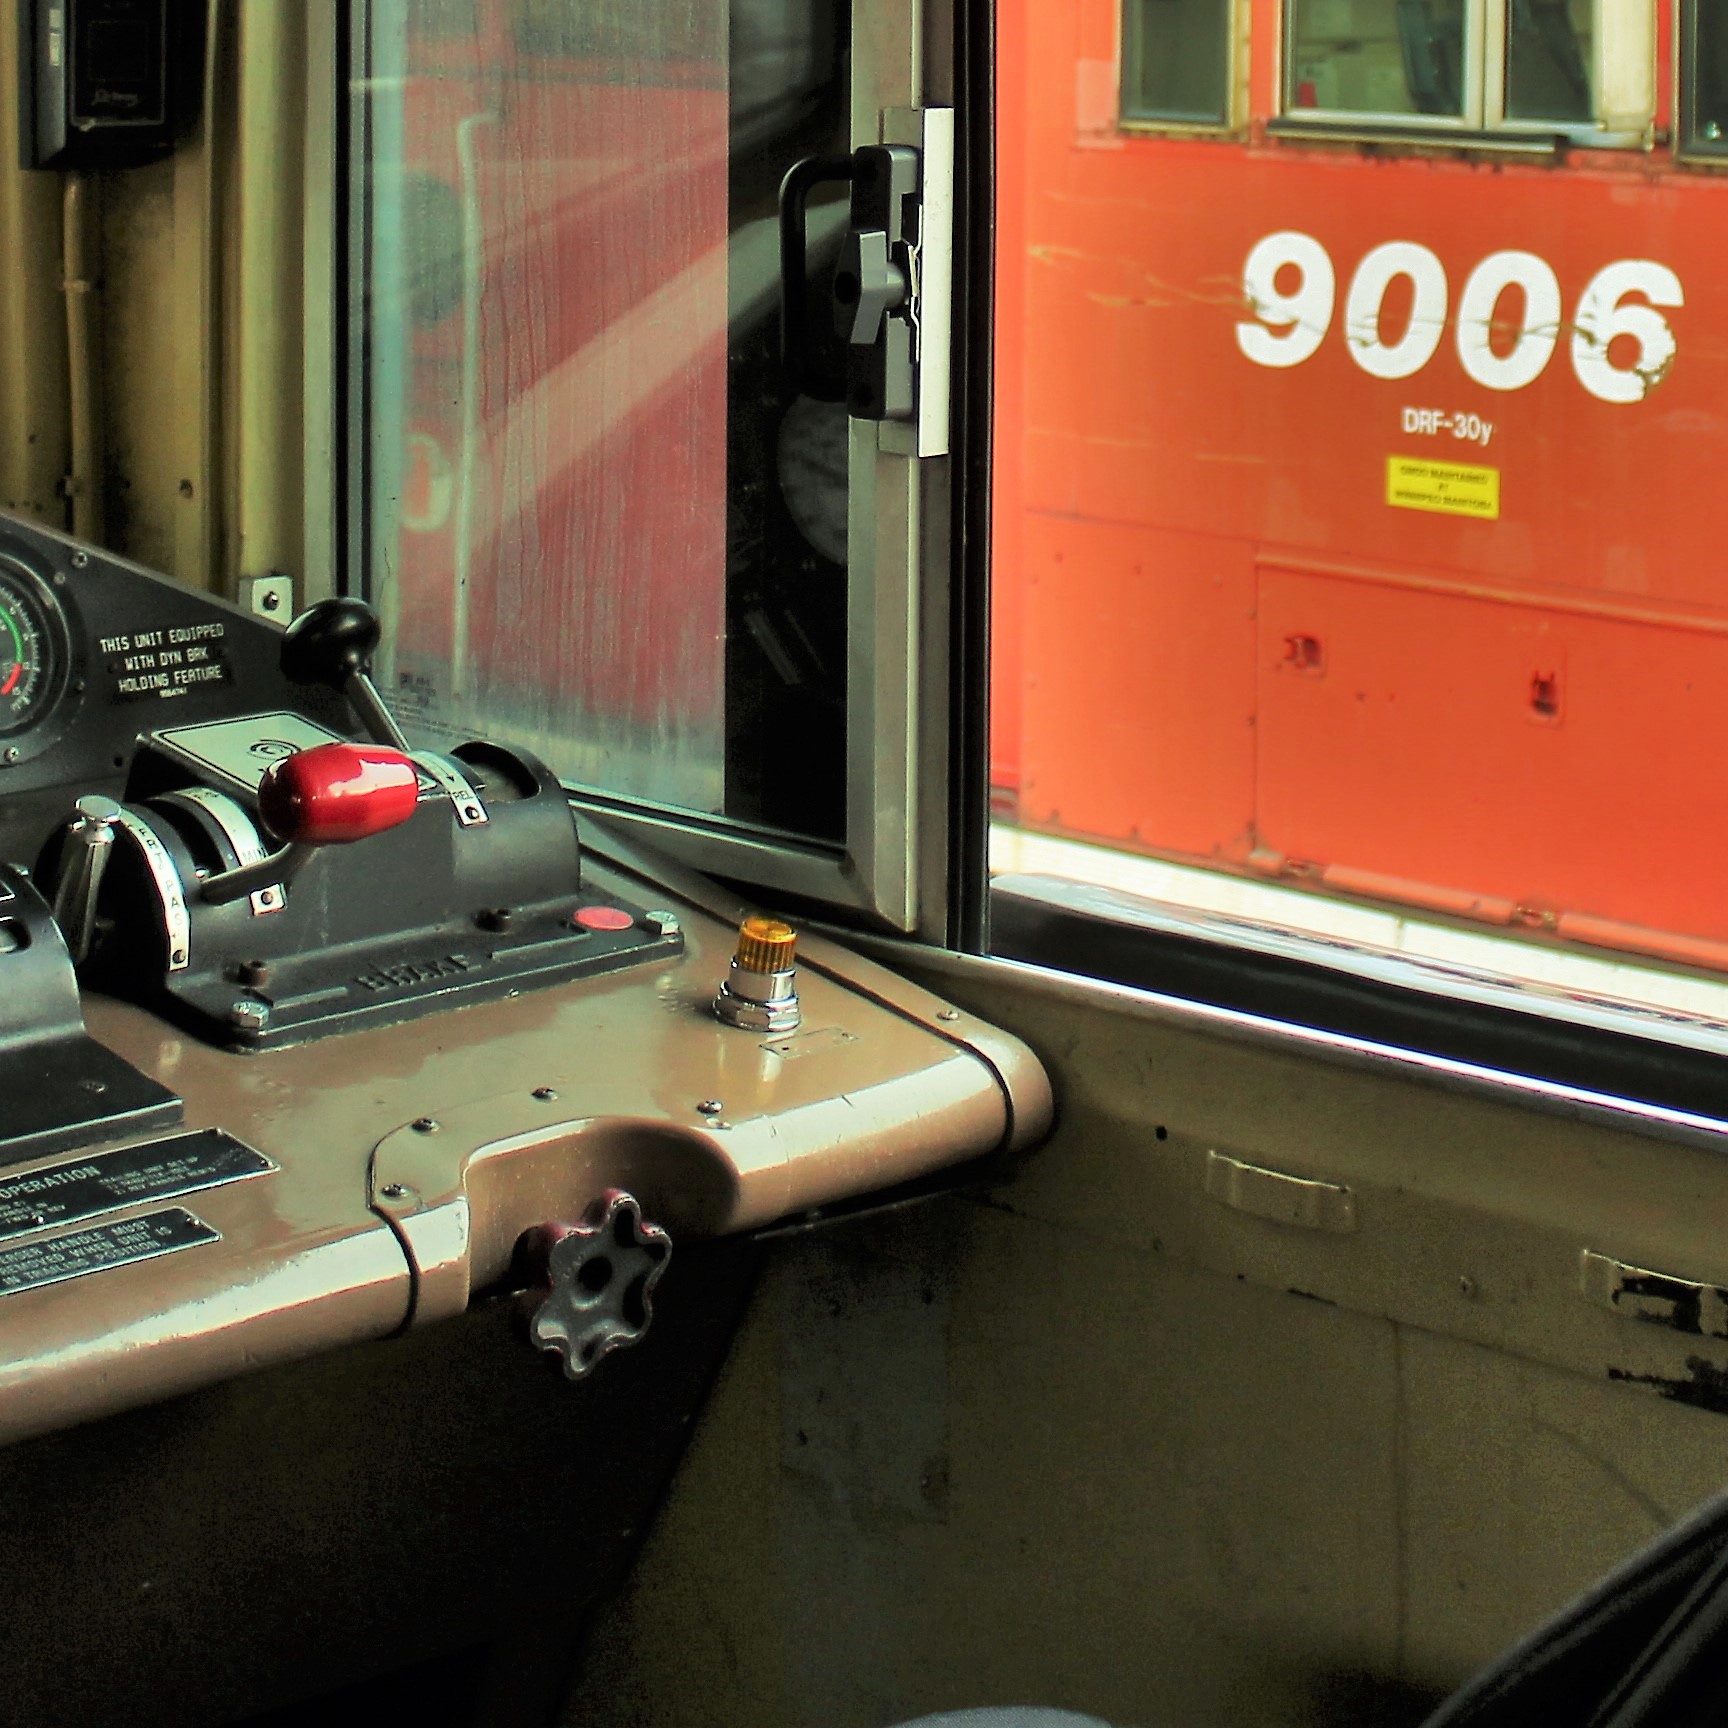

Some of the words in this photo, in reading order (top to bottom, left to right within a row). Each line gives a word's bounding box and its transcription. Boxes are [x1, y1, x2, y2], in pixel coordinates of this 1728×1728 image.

[1235, 230, 1685, 404] 9006
[1402, 407, 1492, 446] DRF-30y
[100, 636, 130, 653] THIS
[134, 631, 162, 648] UNIT
[168, 623, 224, 643] EQUIPPED
[124, 654, 155, 671] WITH
[159, 651, 183, 666] DYN
[118, 672, 170, 692] HOLDING
[174, 665, 223, 684] FEATURE
[47, 1231, 106, 1252] HANDLE
[69, 1239, 115, 1259] WHEN
